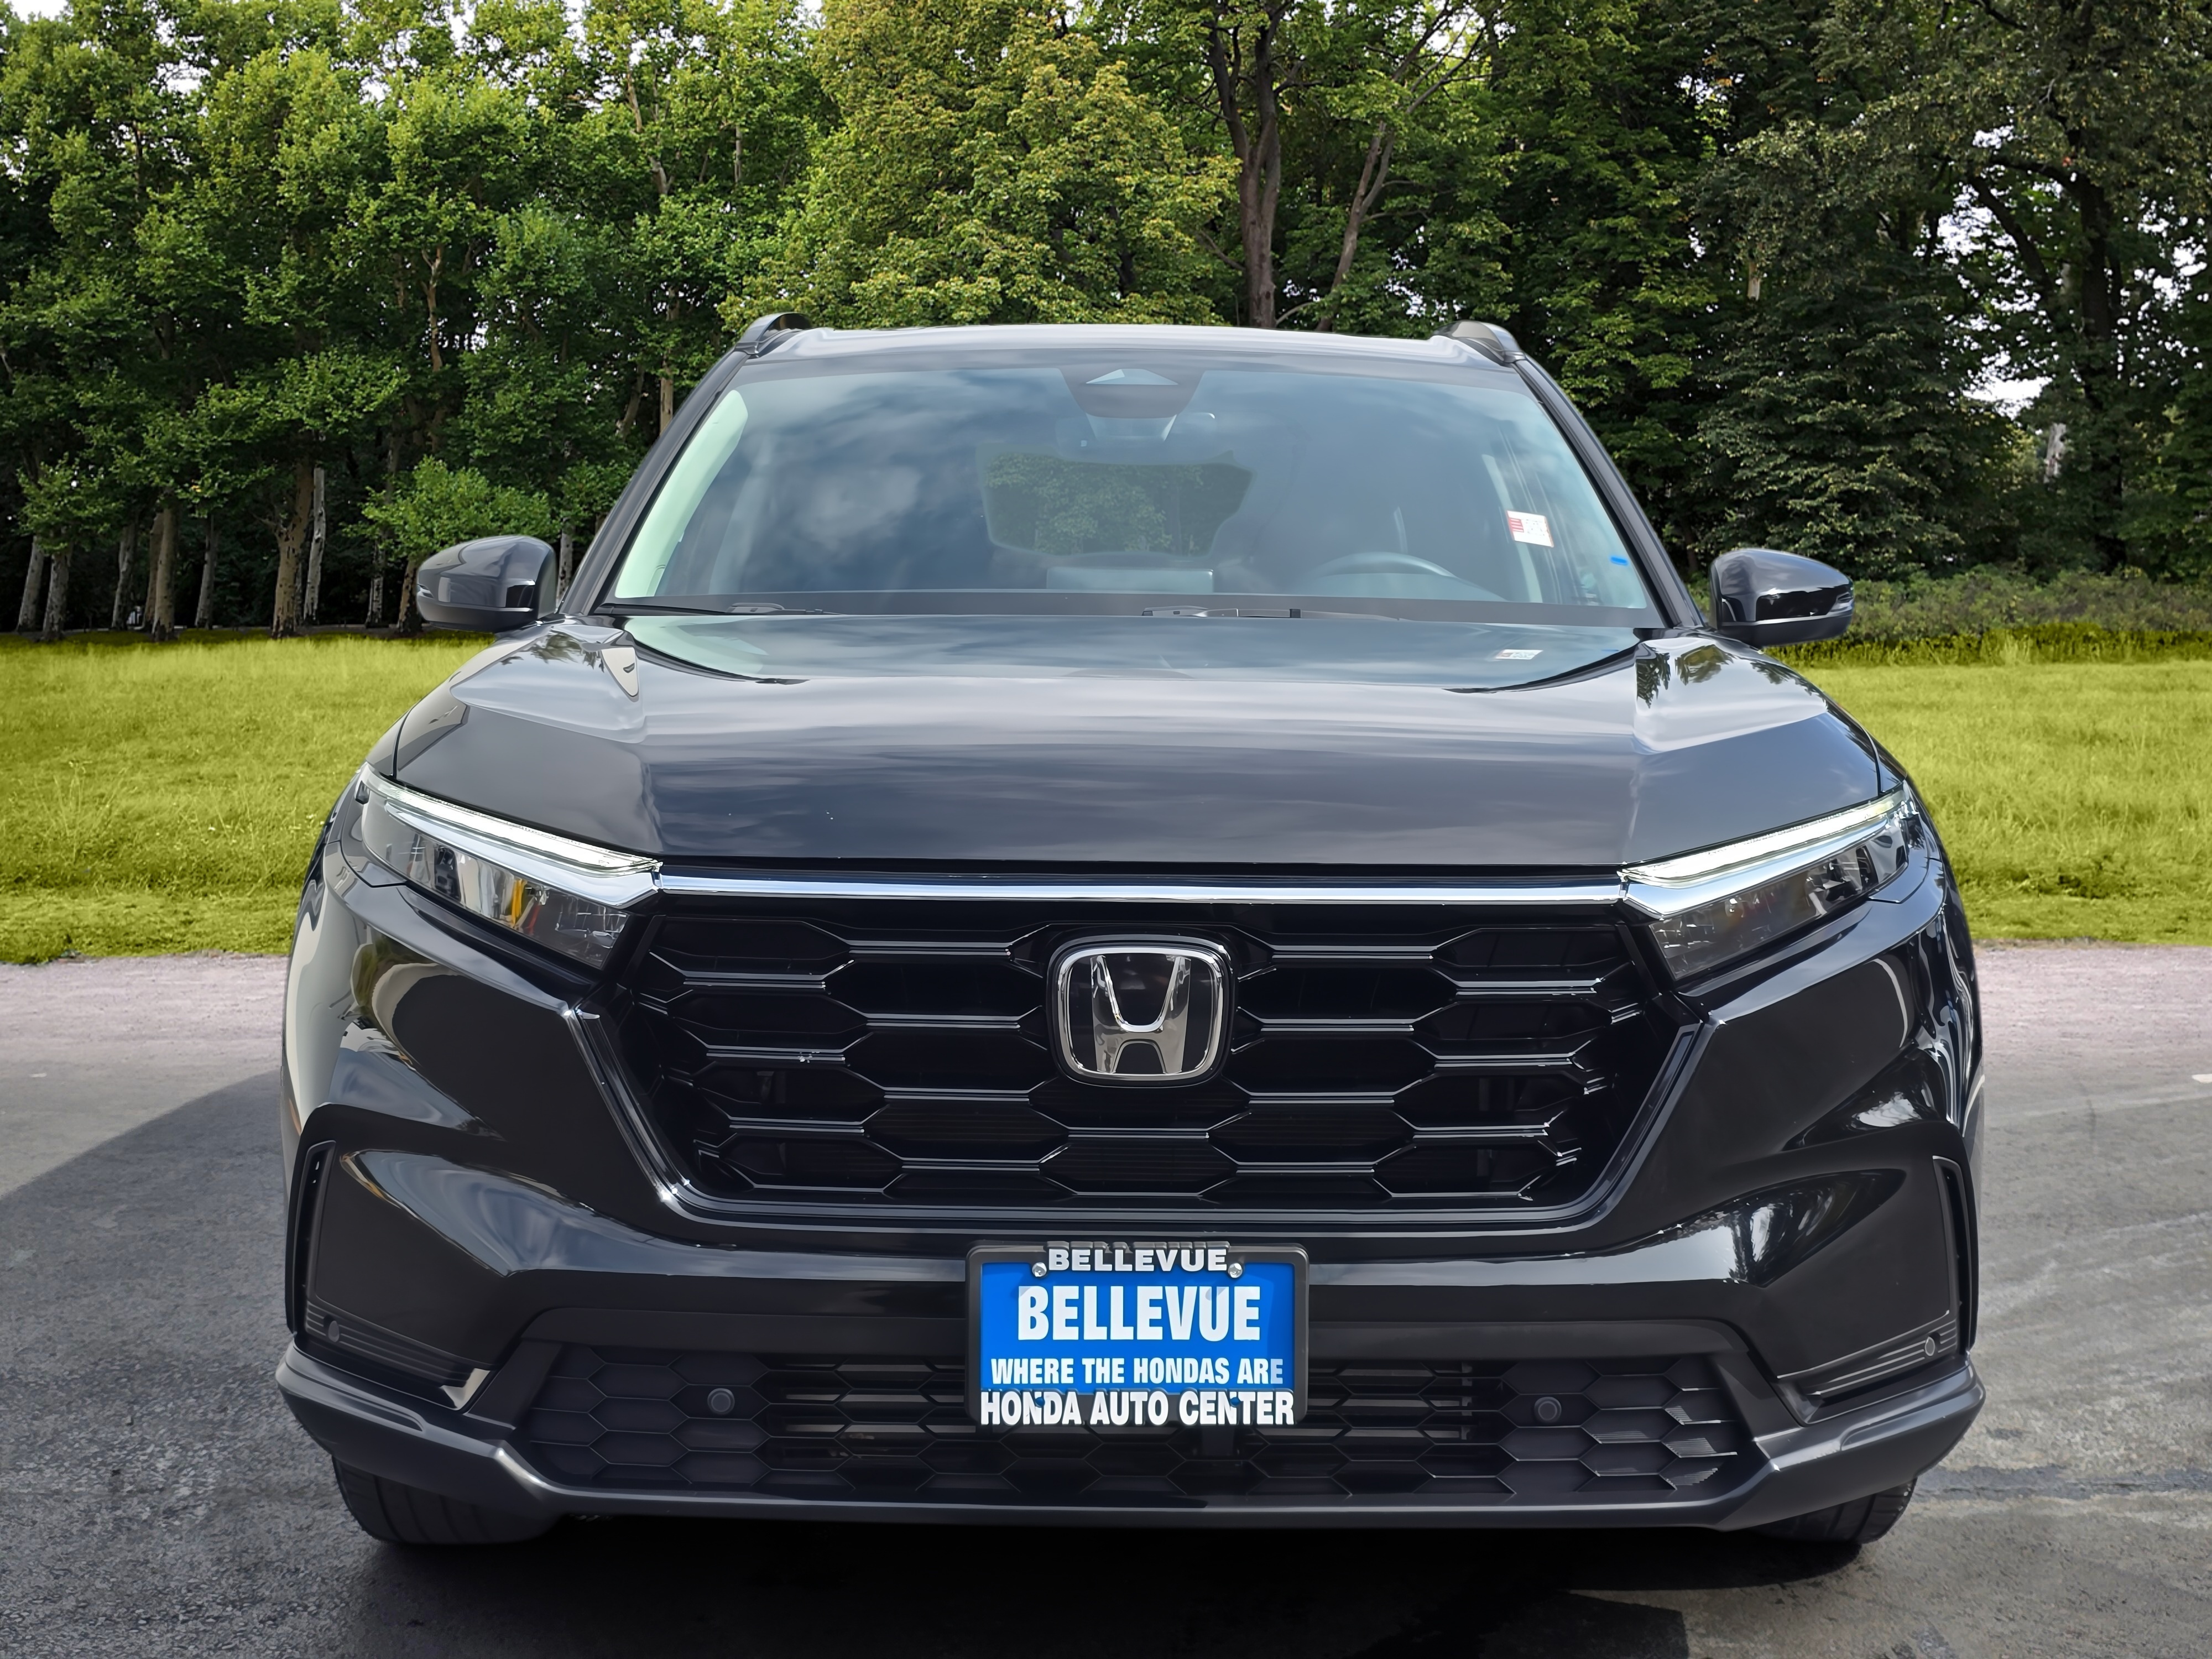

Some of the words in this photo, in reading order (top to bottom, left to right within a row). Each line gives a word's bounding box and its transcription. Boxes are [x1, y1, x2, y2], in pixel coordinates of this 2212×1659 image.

[1048, 1248, 1227, 1272] BELLEVUE
[1018, 1286, 1260, 1342] BELLEVUE
[991, 1358, 1074, 1384] WHERE
[1082, 1358, 1125, 1384] THE
[1134, 1357, 1230, 1384] HONDAS
[1237, 1358, 1283, 1384] ARE
[980, 1391, 1083, 1425] HONDA
[1089, 1391, 1168, 1425] AUTO
[1179, 1391, 1295, 1425] CENTER
